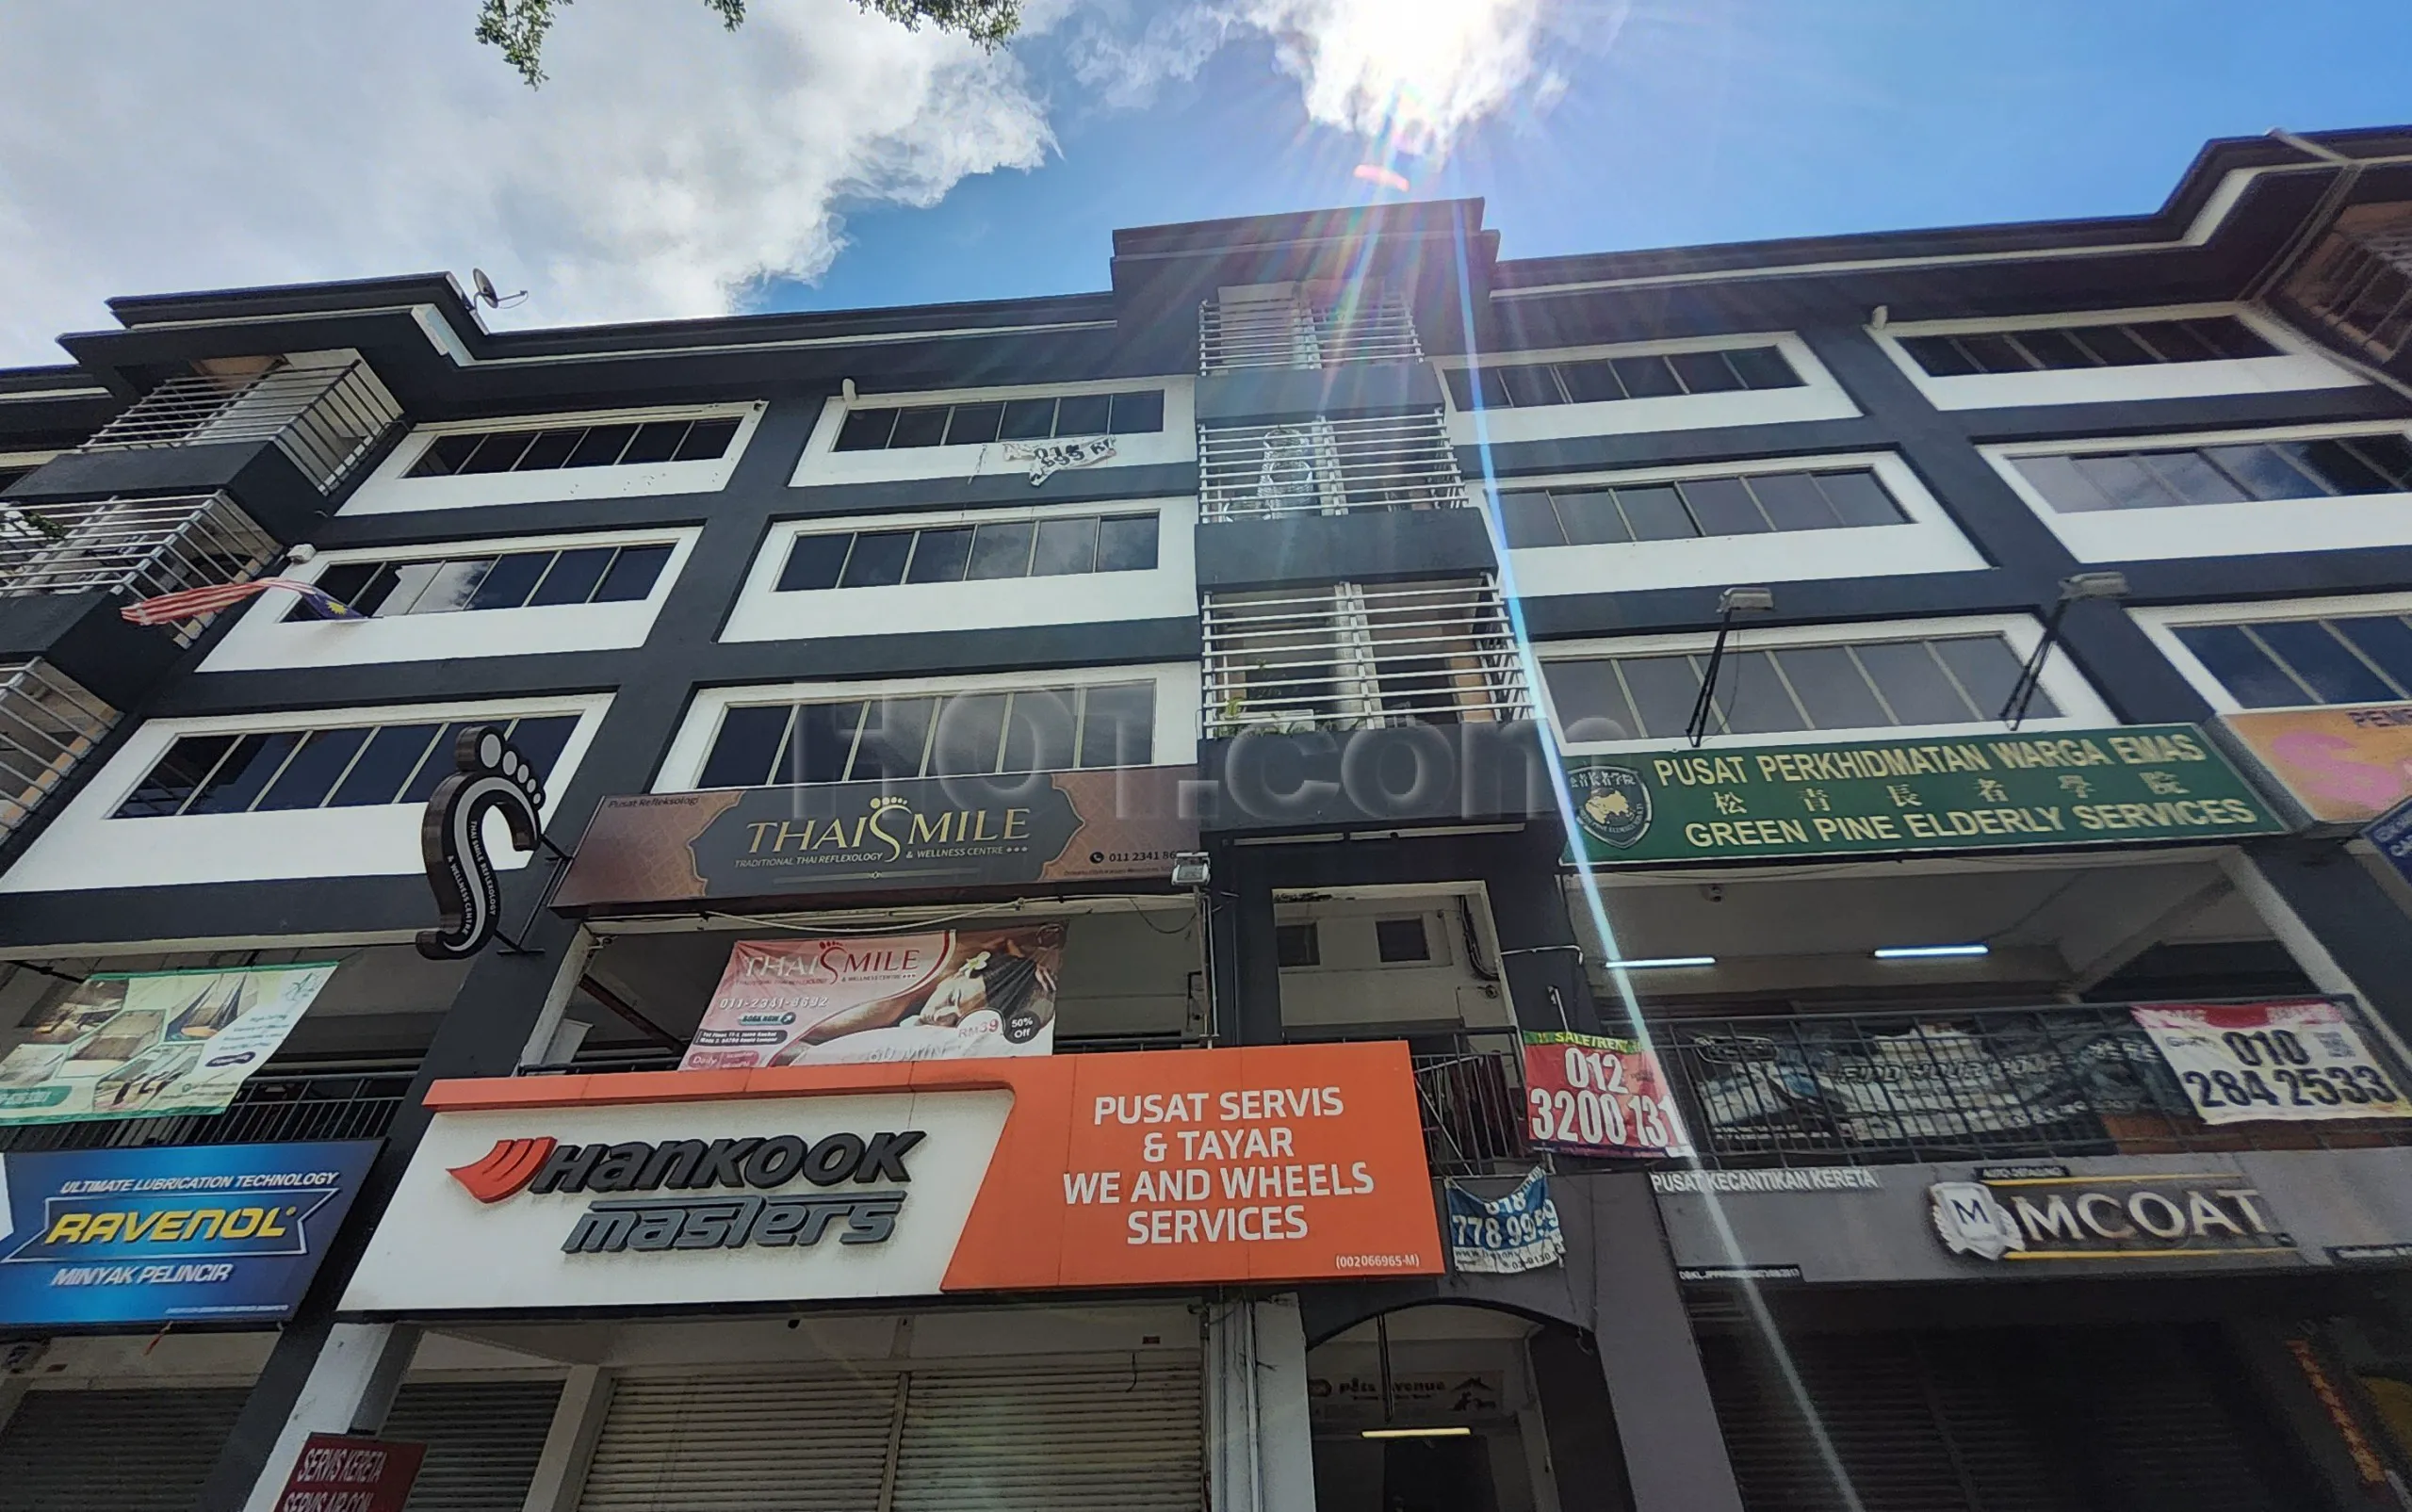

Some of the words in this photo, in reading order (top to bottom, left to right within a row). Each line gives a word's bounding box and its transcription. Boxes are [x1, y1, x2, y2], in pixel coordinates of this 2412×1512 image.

[1654, 756, 1748, 787] PUSAT
[1756, 743, 1991, 783] PERKHIDMATAN
[1988, 739, 2114, 769] WARGA
[2109, 734, 2207, 764] EMAS
[1686, 818, 1809, 847] GREEN
[1812, 816, 1901, 841] PINE
[1903, 806, 2065, 837] ELDERLY
[2073, 799, 2257, 830] SERVICES
[734, 857, 794, 868] TRADITIONAL
[796, 856, 817, 866] THAI
[818, 852, 883, 865] REFLEXOLOGY
[906, 851, 914, 859] &
[917, 848, 966, 858] WELLNESS
[967, 846, 1002, 856] CENTRE
[1109, 852, 1129, 863] 011
[1132, 851, 1160, 862] 2341
[1011, 1016, 1033, 1028] 50%
[1014, 1028, 1031, 1039] Off
[2222, 1029, 2311, 1066] 010
[1565, 1047, 1628, 1095] 012
[2182, 1069, 2280, 1107] 284
[2273, 1065, 2398, 1106] 2533
[1094, 1092, 1209, 1126] PUSAT
[1219, 1086, 1344, 1121] SERVIS
[1531, 1088, 1627, 1145] 3200
[1144, 1132, 1167, 1162] &
[1177, 1127, 1295, 1162] TAYAR
[60, 1179, 135, 1195] ULTIMATE
[134, 1176, 233, 1191] LUBRICATION
[235, 1171, 340, 1188] TECHNOLOGY
[1063, 1171, 1121, 1204] WE
[1131, 1168, 1210, 1202] AND
[1220, 1162, 1375, 1200] WHEELS
[1651, 1173, 1705, 1194] PUSAT
[1708, 1171, 1810, 1192] KECANTIKAN
[1811, 1169, 1880, 1189] KERETA
[1127, 1205, 1308, 1245] SERVICES
[1949, 1196, 1990, 1227] M
[2012, 1189, 2269, 1242] MCOAT
[1452, 1214, 1502, 1248] 778
[50, 1264, 141, 1287] MINYAK
[138, 1263, 234, 1285] PELINCIR
[1391, 1381, 1446, 1392] venue
[297, 1448, 348, 1483] SERVIS
[340, 1449, 388, 1484] KERETA
